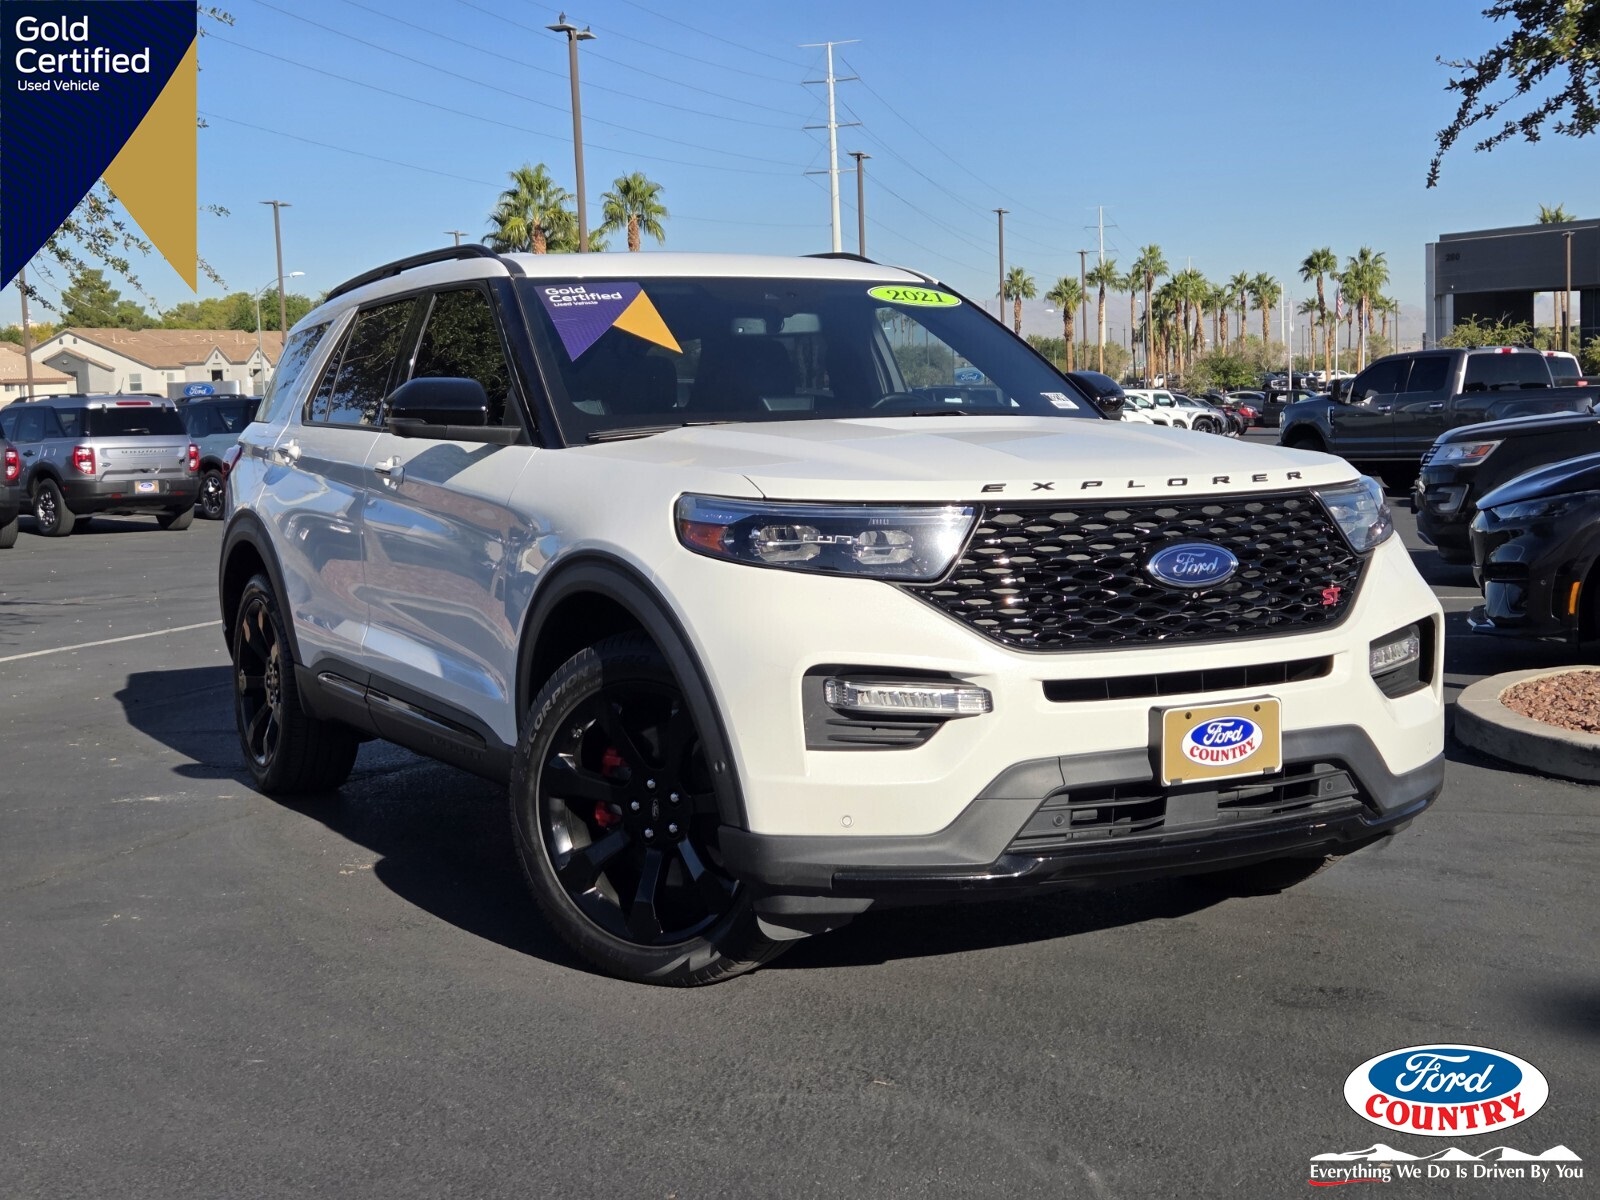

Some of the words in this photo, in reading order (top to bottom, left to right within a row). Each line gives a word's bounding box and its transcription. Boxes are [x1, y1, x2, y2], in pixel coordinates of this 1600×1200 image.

[545, 286, 586, 295] Gold
[549, 292, 622, 302] Certified
[886, 289, 946, 303] 2021
[188, 385, 208, 395] Ford
[980, 470, 1304, 493] EXPLORER
[1172, 552, 1219, 577] Ford
[1322, 586, 1341, 605] ST
[524, 666, 590, 759] SCORPION
[1202, 721, 1244, 746] Ford
[1189, 737, 1256, 762] COUNTRY
